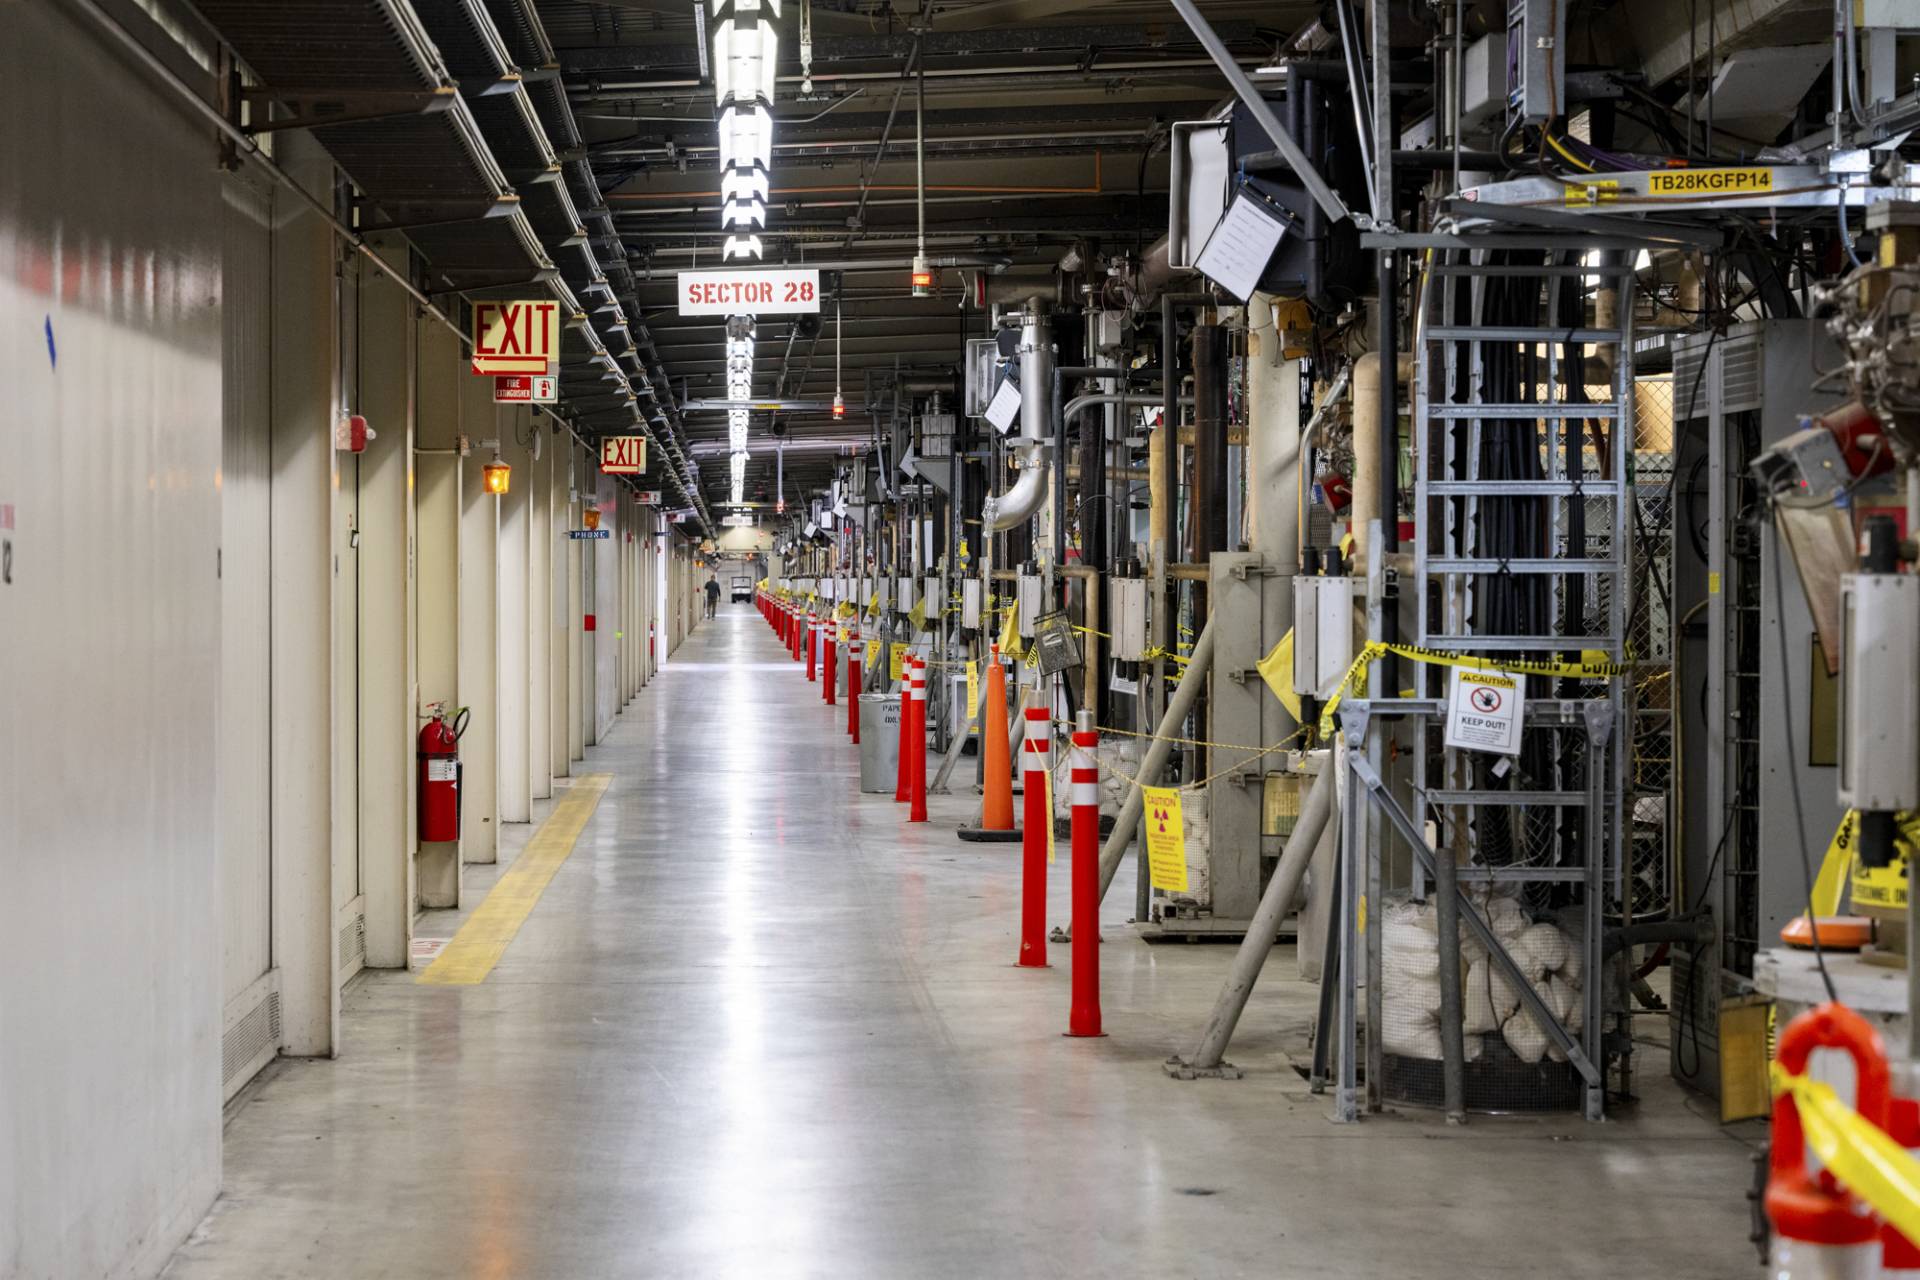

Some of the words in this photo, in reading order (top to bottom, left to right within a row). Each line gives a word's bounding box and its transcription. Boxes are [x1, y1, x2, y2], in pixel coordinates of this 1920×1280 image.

[1651, 172, 1770, 190] TB28KGFP14
[688, 281, 773, 304] SECTOR
[784, 281, 814, 302] 28
[476, 304, 555, 354] EXIT
[506, 379, 520, 388] FIRE
[496, 389, 531, 398] EXTINGUISHER
[603, 439, 643, 465] EXIT
[575, 531, 605, 539] PHONE
[1471, 675, 1513, 687] CAUTION
[1461, 716, 1484, 727] KEEP
[1485, 720, 1506, 731] OUT!
[1146, 795, 1176, 807] CAUTION
